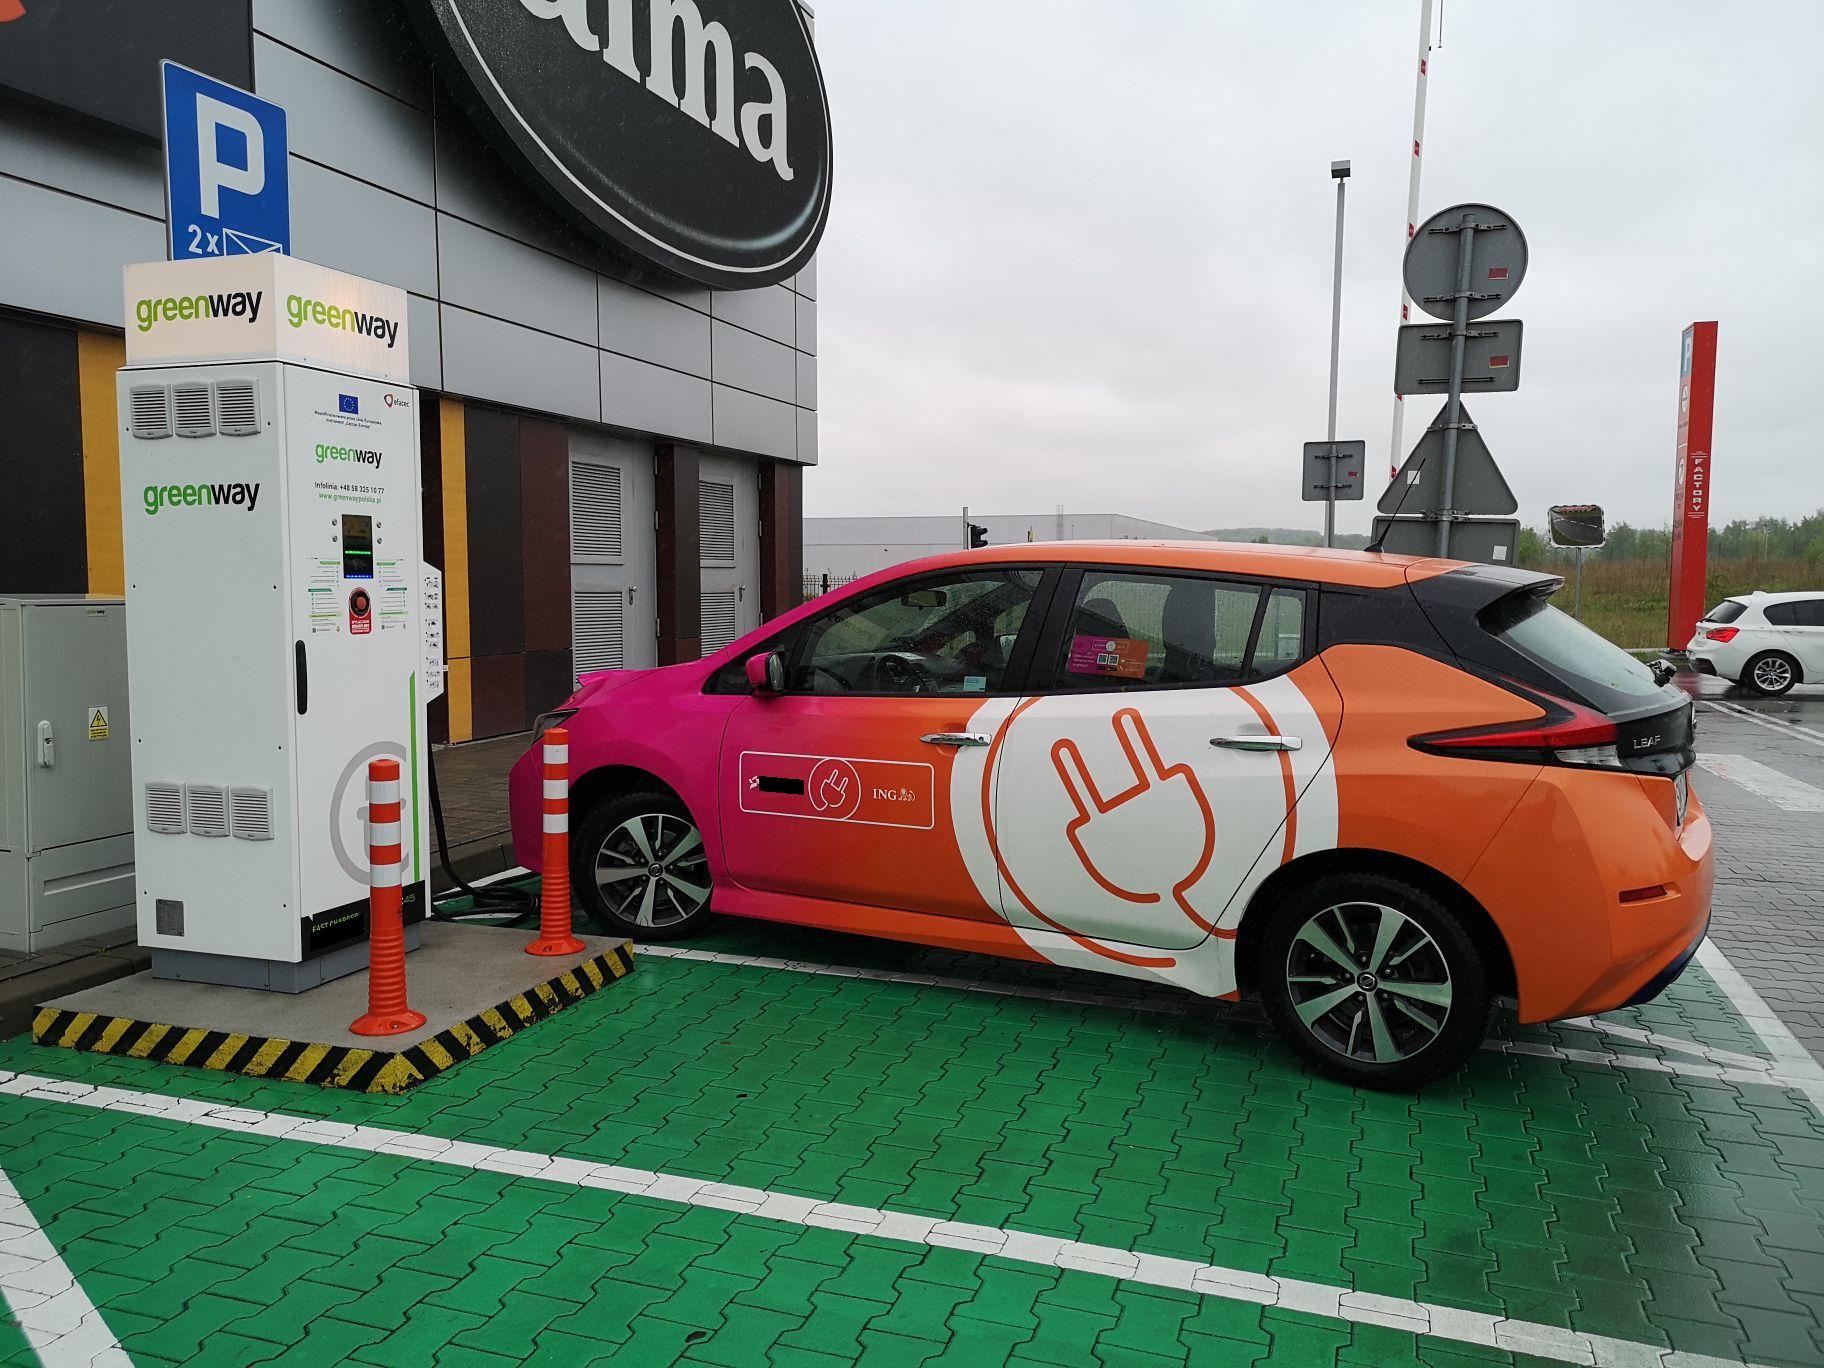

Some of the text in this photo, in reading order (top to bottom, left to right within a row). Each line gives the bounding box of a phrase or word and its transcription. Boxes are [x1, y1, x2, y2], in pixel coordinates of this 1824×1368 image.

[195, 92, 265, 219] P
[188, 224, 203, 254] 2
[136, 291, 263, 332] greenway
[287, 294, 399, 348] greenway
[1684, 332, 1692, 371] P
[394, 398, 410, 408] efacec
[316, 444, 382, 469] greenway
[144, 483, 260, 515] greenway
[1693, 458, 1704, 511] FACTORY
[1633, 735, 1662, 749] LEAF
[872, 788, 897, 801] ING
[402, 894, 416, 906] 45
